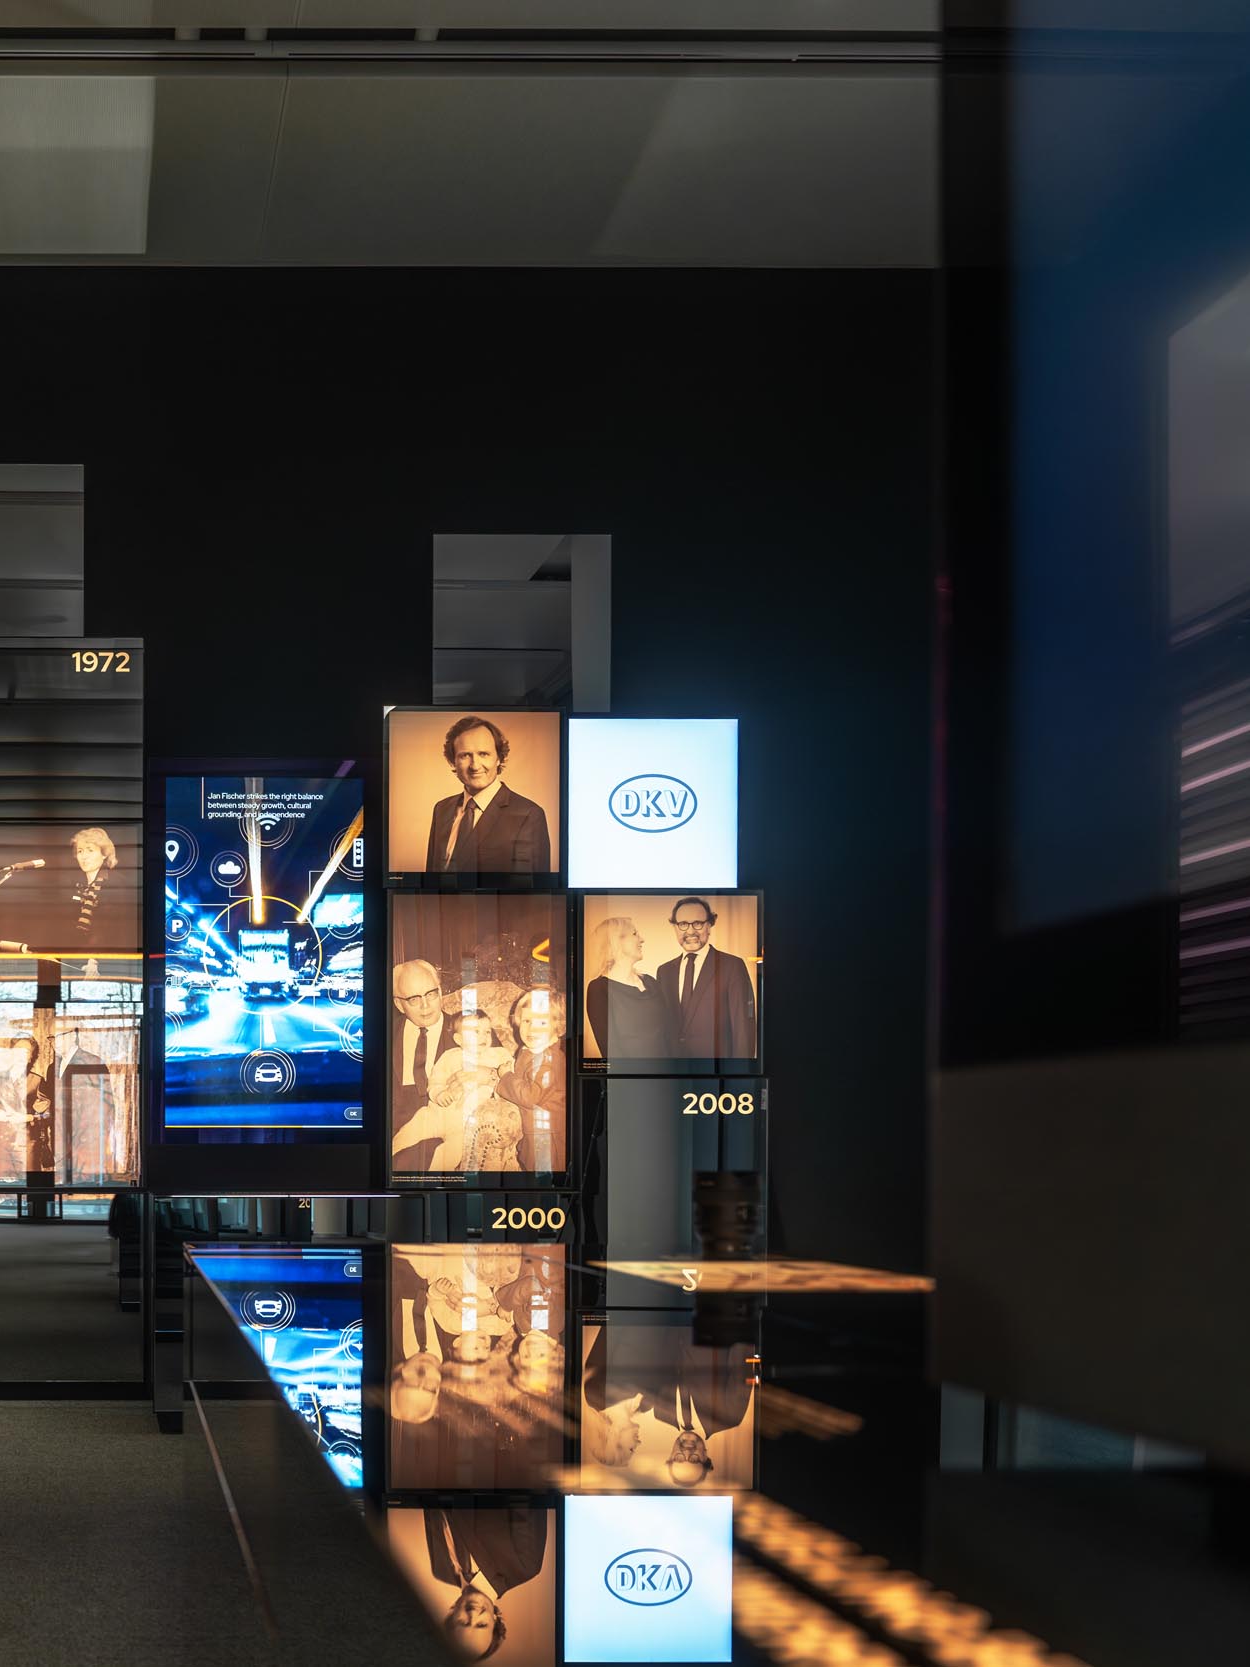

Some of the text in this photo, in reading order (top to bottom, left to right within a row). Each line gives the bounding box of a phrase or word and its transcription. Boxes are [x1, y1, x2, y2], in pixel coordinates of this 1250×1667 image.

[71, 651, 130, 673] 1972
[207, 792, 324, 802] Jan Fischer strikes the right balance
[207, 801, 312, 811] between steady growth, cultural
[619, 789, 689, 818] DKV
[244, 811, 258, 819] and
[258, 811, 306, 820] independence
[682, 1093, 754, 1115] 2008
[491, 1207, 566, 1230] 2000
